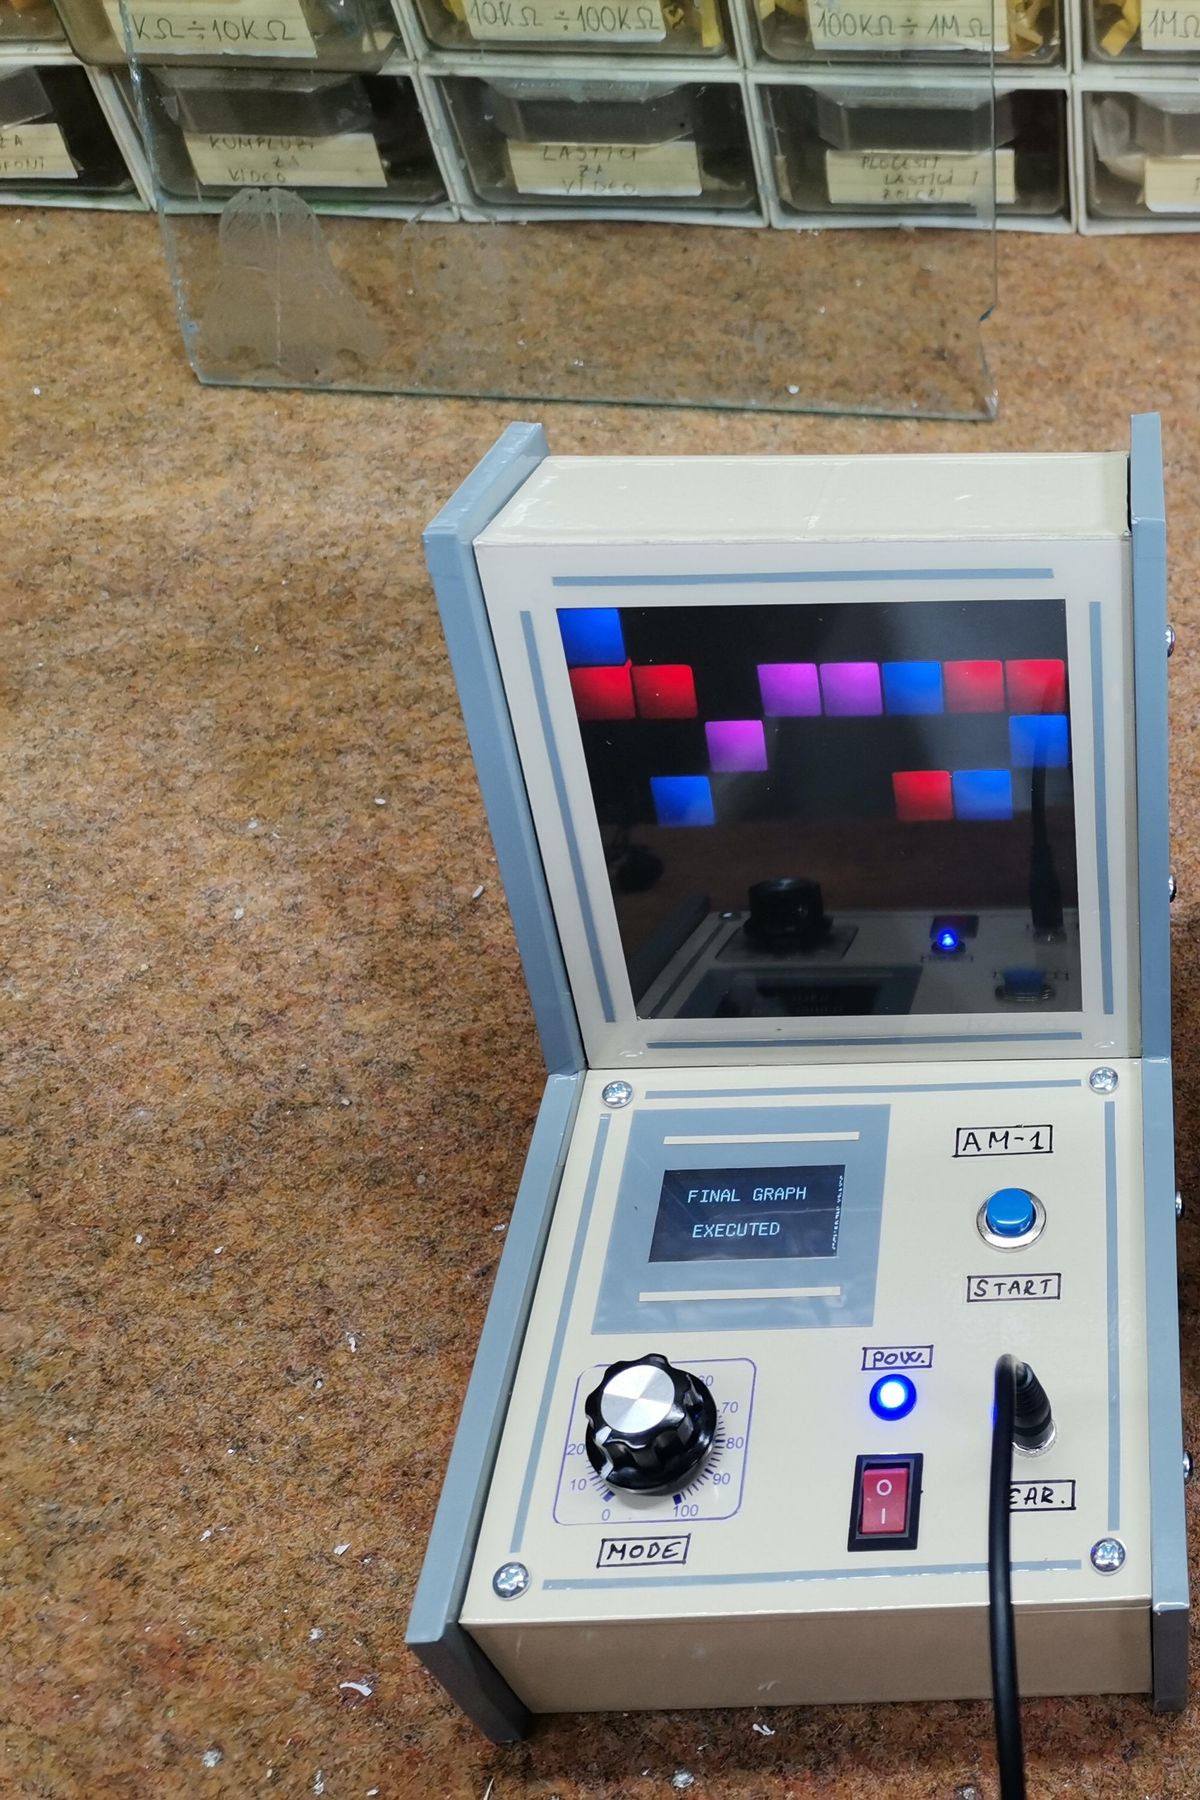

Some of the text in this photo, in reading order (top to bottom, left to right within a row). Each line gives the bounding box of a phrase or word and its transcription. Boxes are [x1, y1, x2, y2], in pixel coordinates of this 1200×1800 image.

[962, 1130, 1045, 1152] AM-1
[687, 1186, 807, 1204] FINAL GRAPH
[692, 1222, 780, 1238] EXECUTED
[973, 1278, 1053, 1298] START
[721, 1401, 739, 1414] 70
[567, 1443, 586, 1456] 20
[726, 1436, 744, 1449] 80
[570, 1477, 587, 1491] 10
[712, 1472, 731, 1485] 90
[673, 1503, 699, 1518] 100
[606, 1541, 682, 1561] MODE
